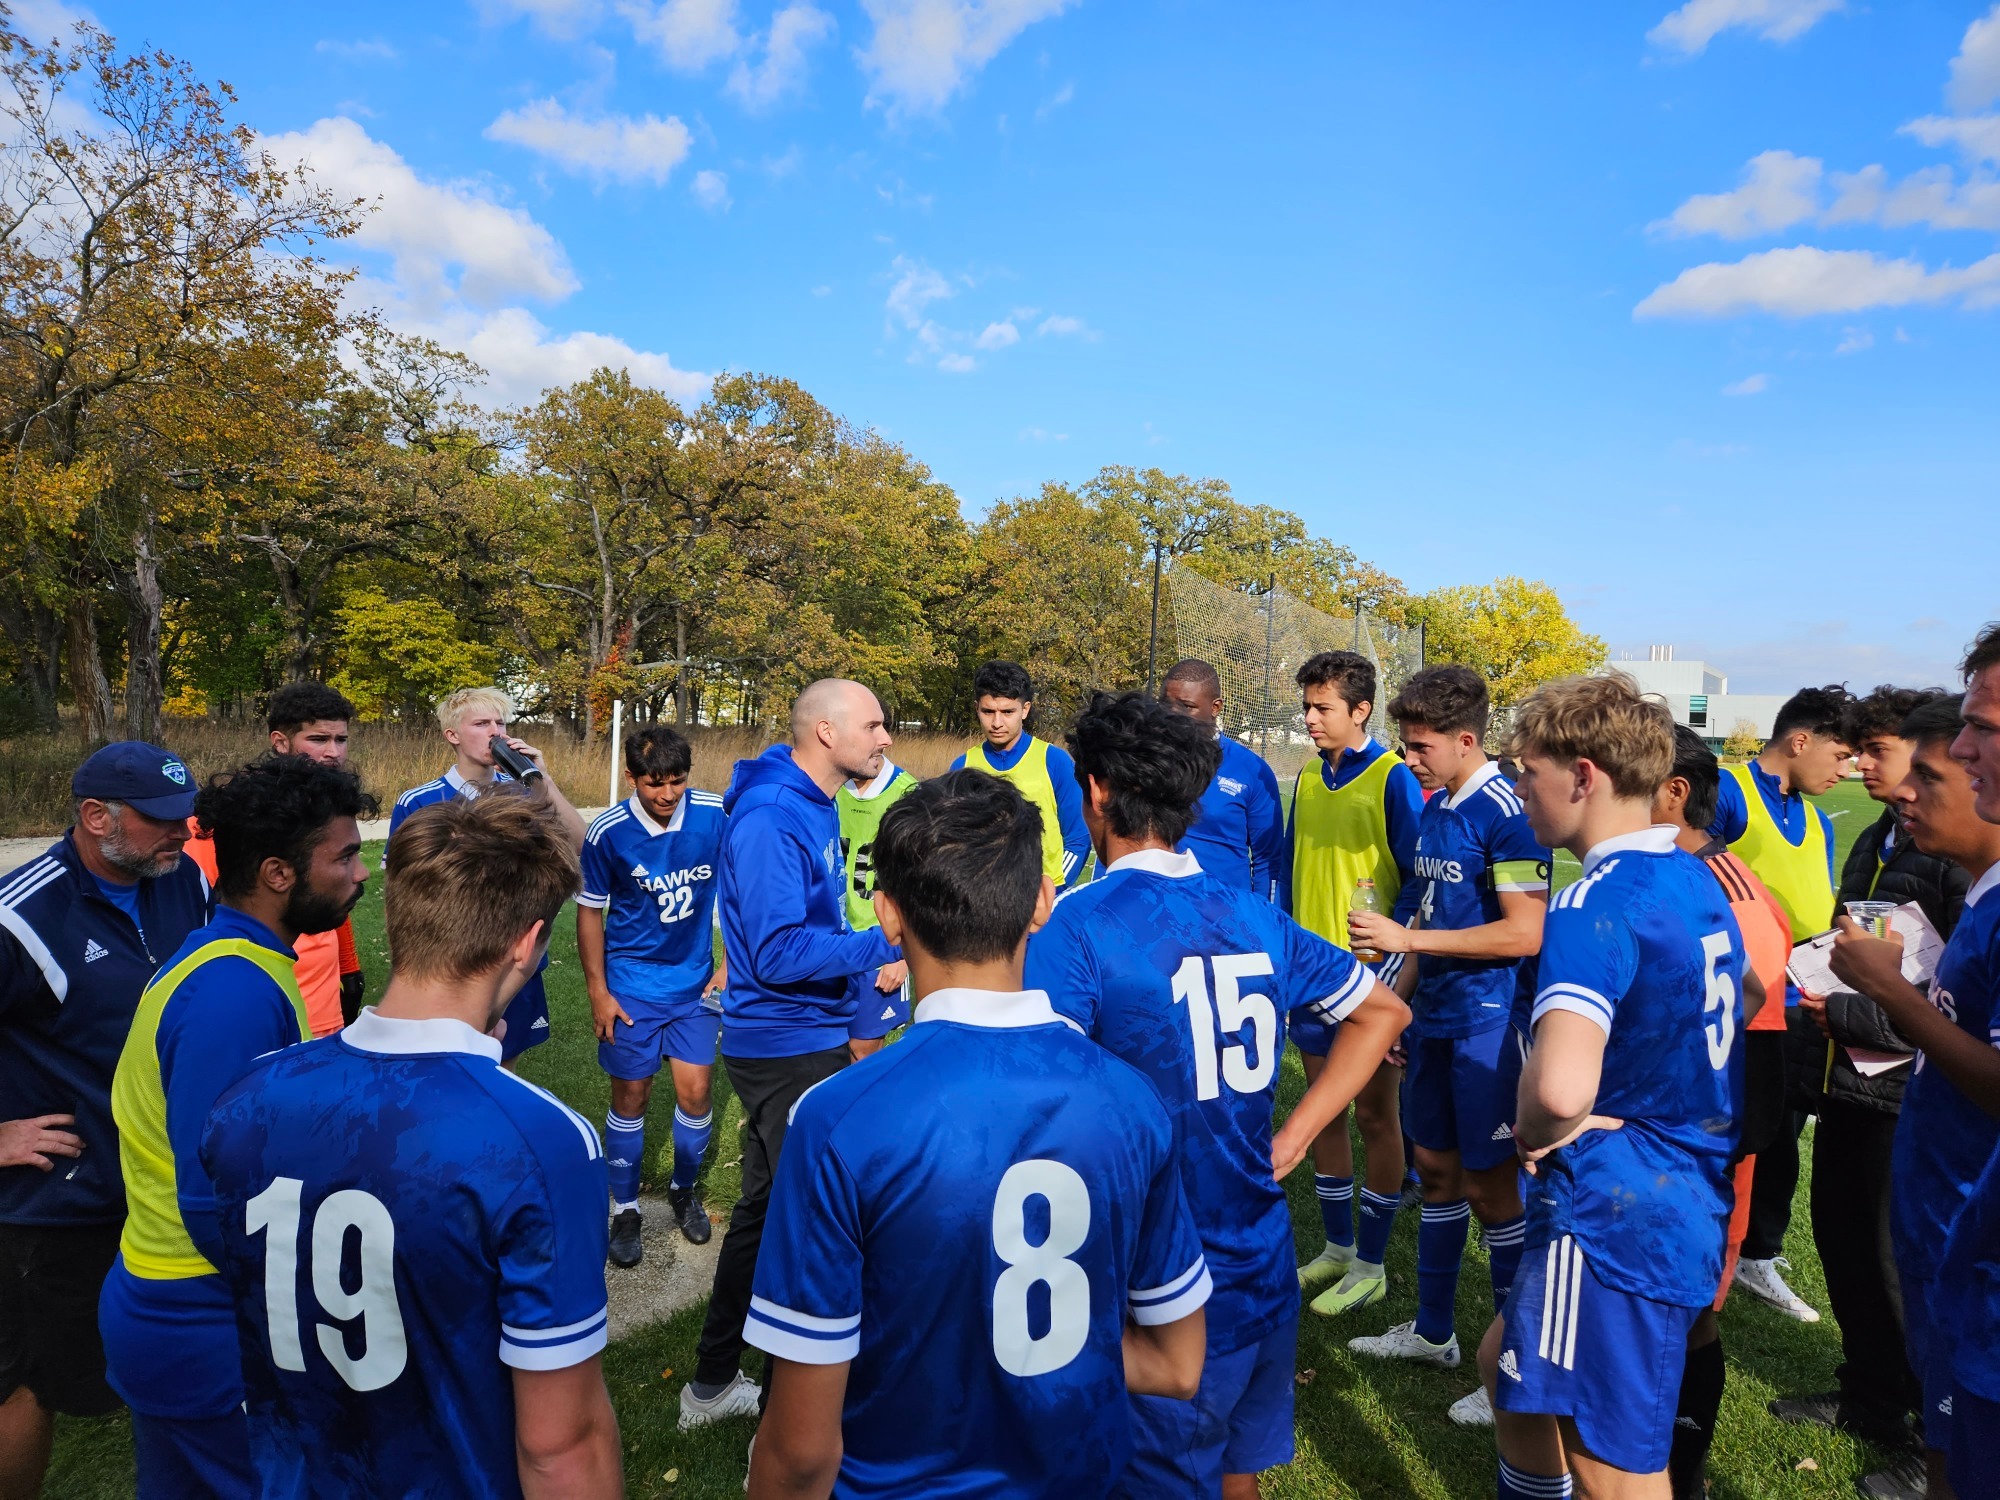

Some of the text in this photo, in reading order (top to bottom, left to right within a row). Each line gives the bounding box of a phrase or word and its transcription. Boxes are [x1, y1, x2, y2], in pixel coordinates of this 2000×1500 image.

[636, 864, 712, 892] HAWKS
[658, 885, 694, 923] 22
[1421, 880, 1435, 921] 4
[84, 949, 109, 963] adidas
[1700, 930, 1736, 1071] 5
[1170, 952, 1277, 1102] 15
[245, 1176, 408, 1392] 19
[992, 1158, 1091, 1377] 8
